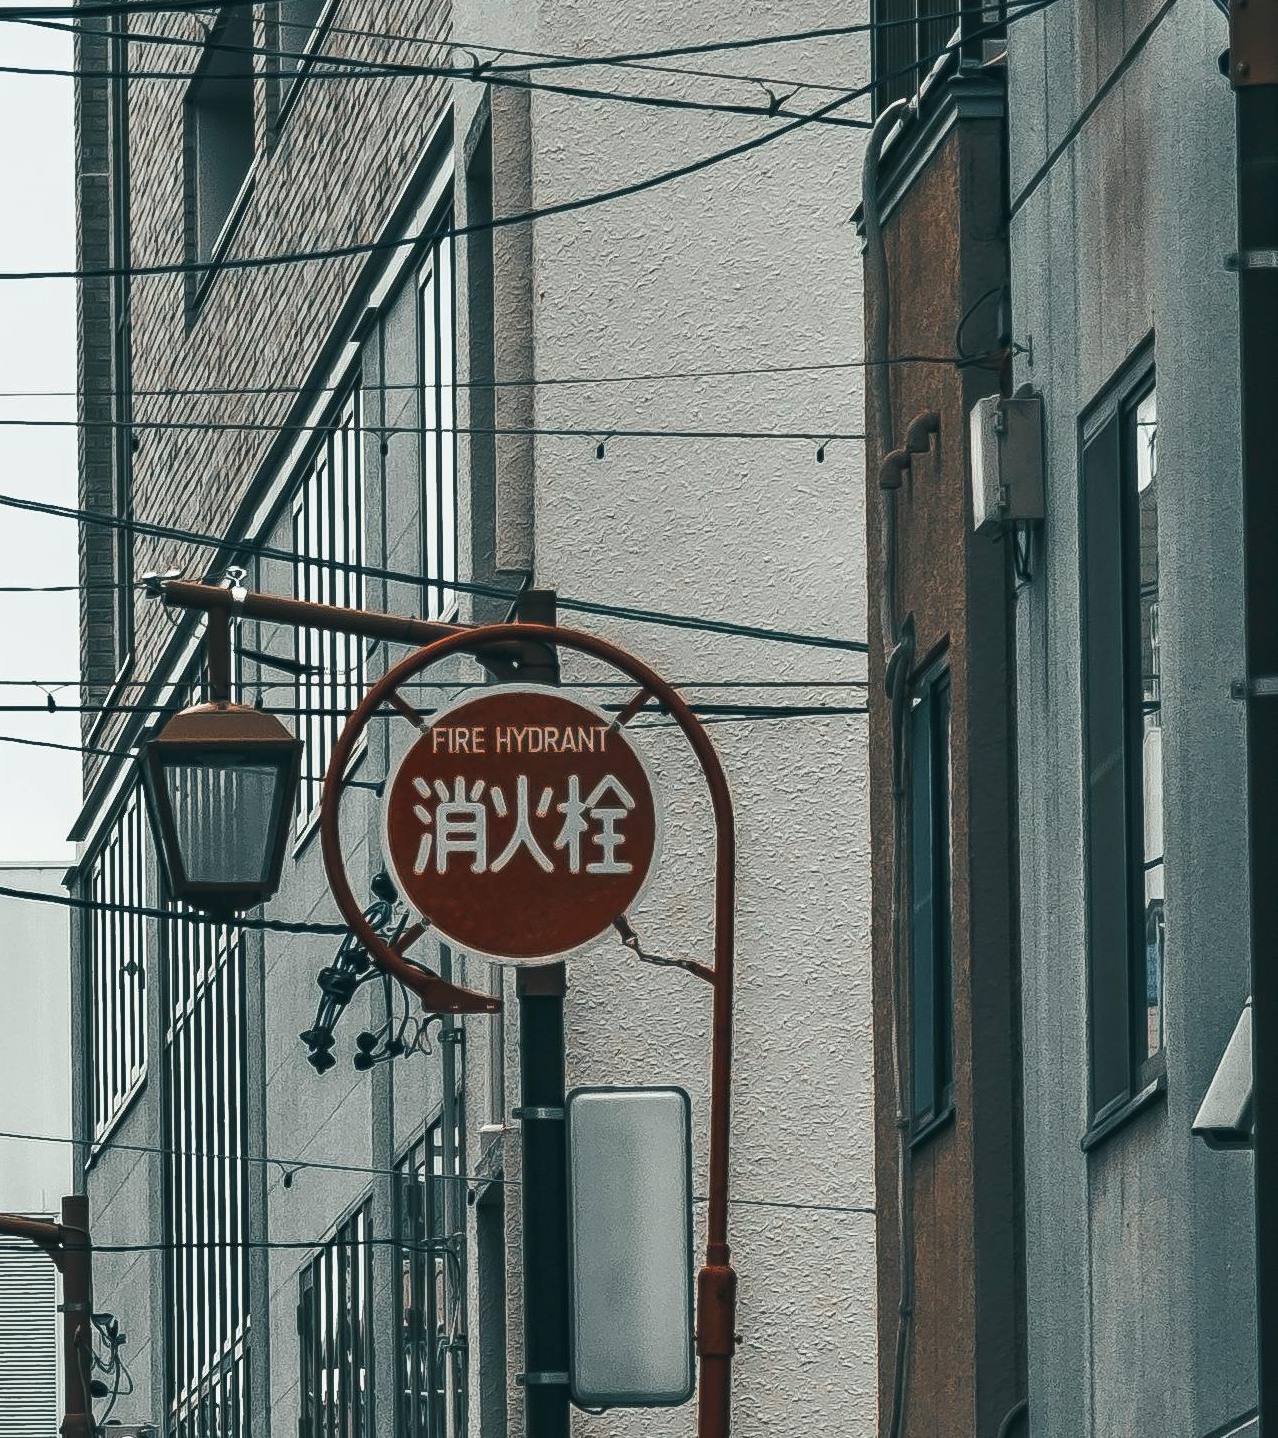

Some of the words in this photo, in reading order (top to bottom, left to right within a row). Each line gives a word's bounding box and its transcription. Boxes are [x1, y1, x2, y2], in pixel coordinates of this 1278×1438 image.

[432, 727, 485, 753] FIRE
[496, 726, 609, 753] HYDRANT
[413, 775, 635, 874] 消火栓
